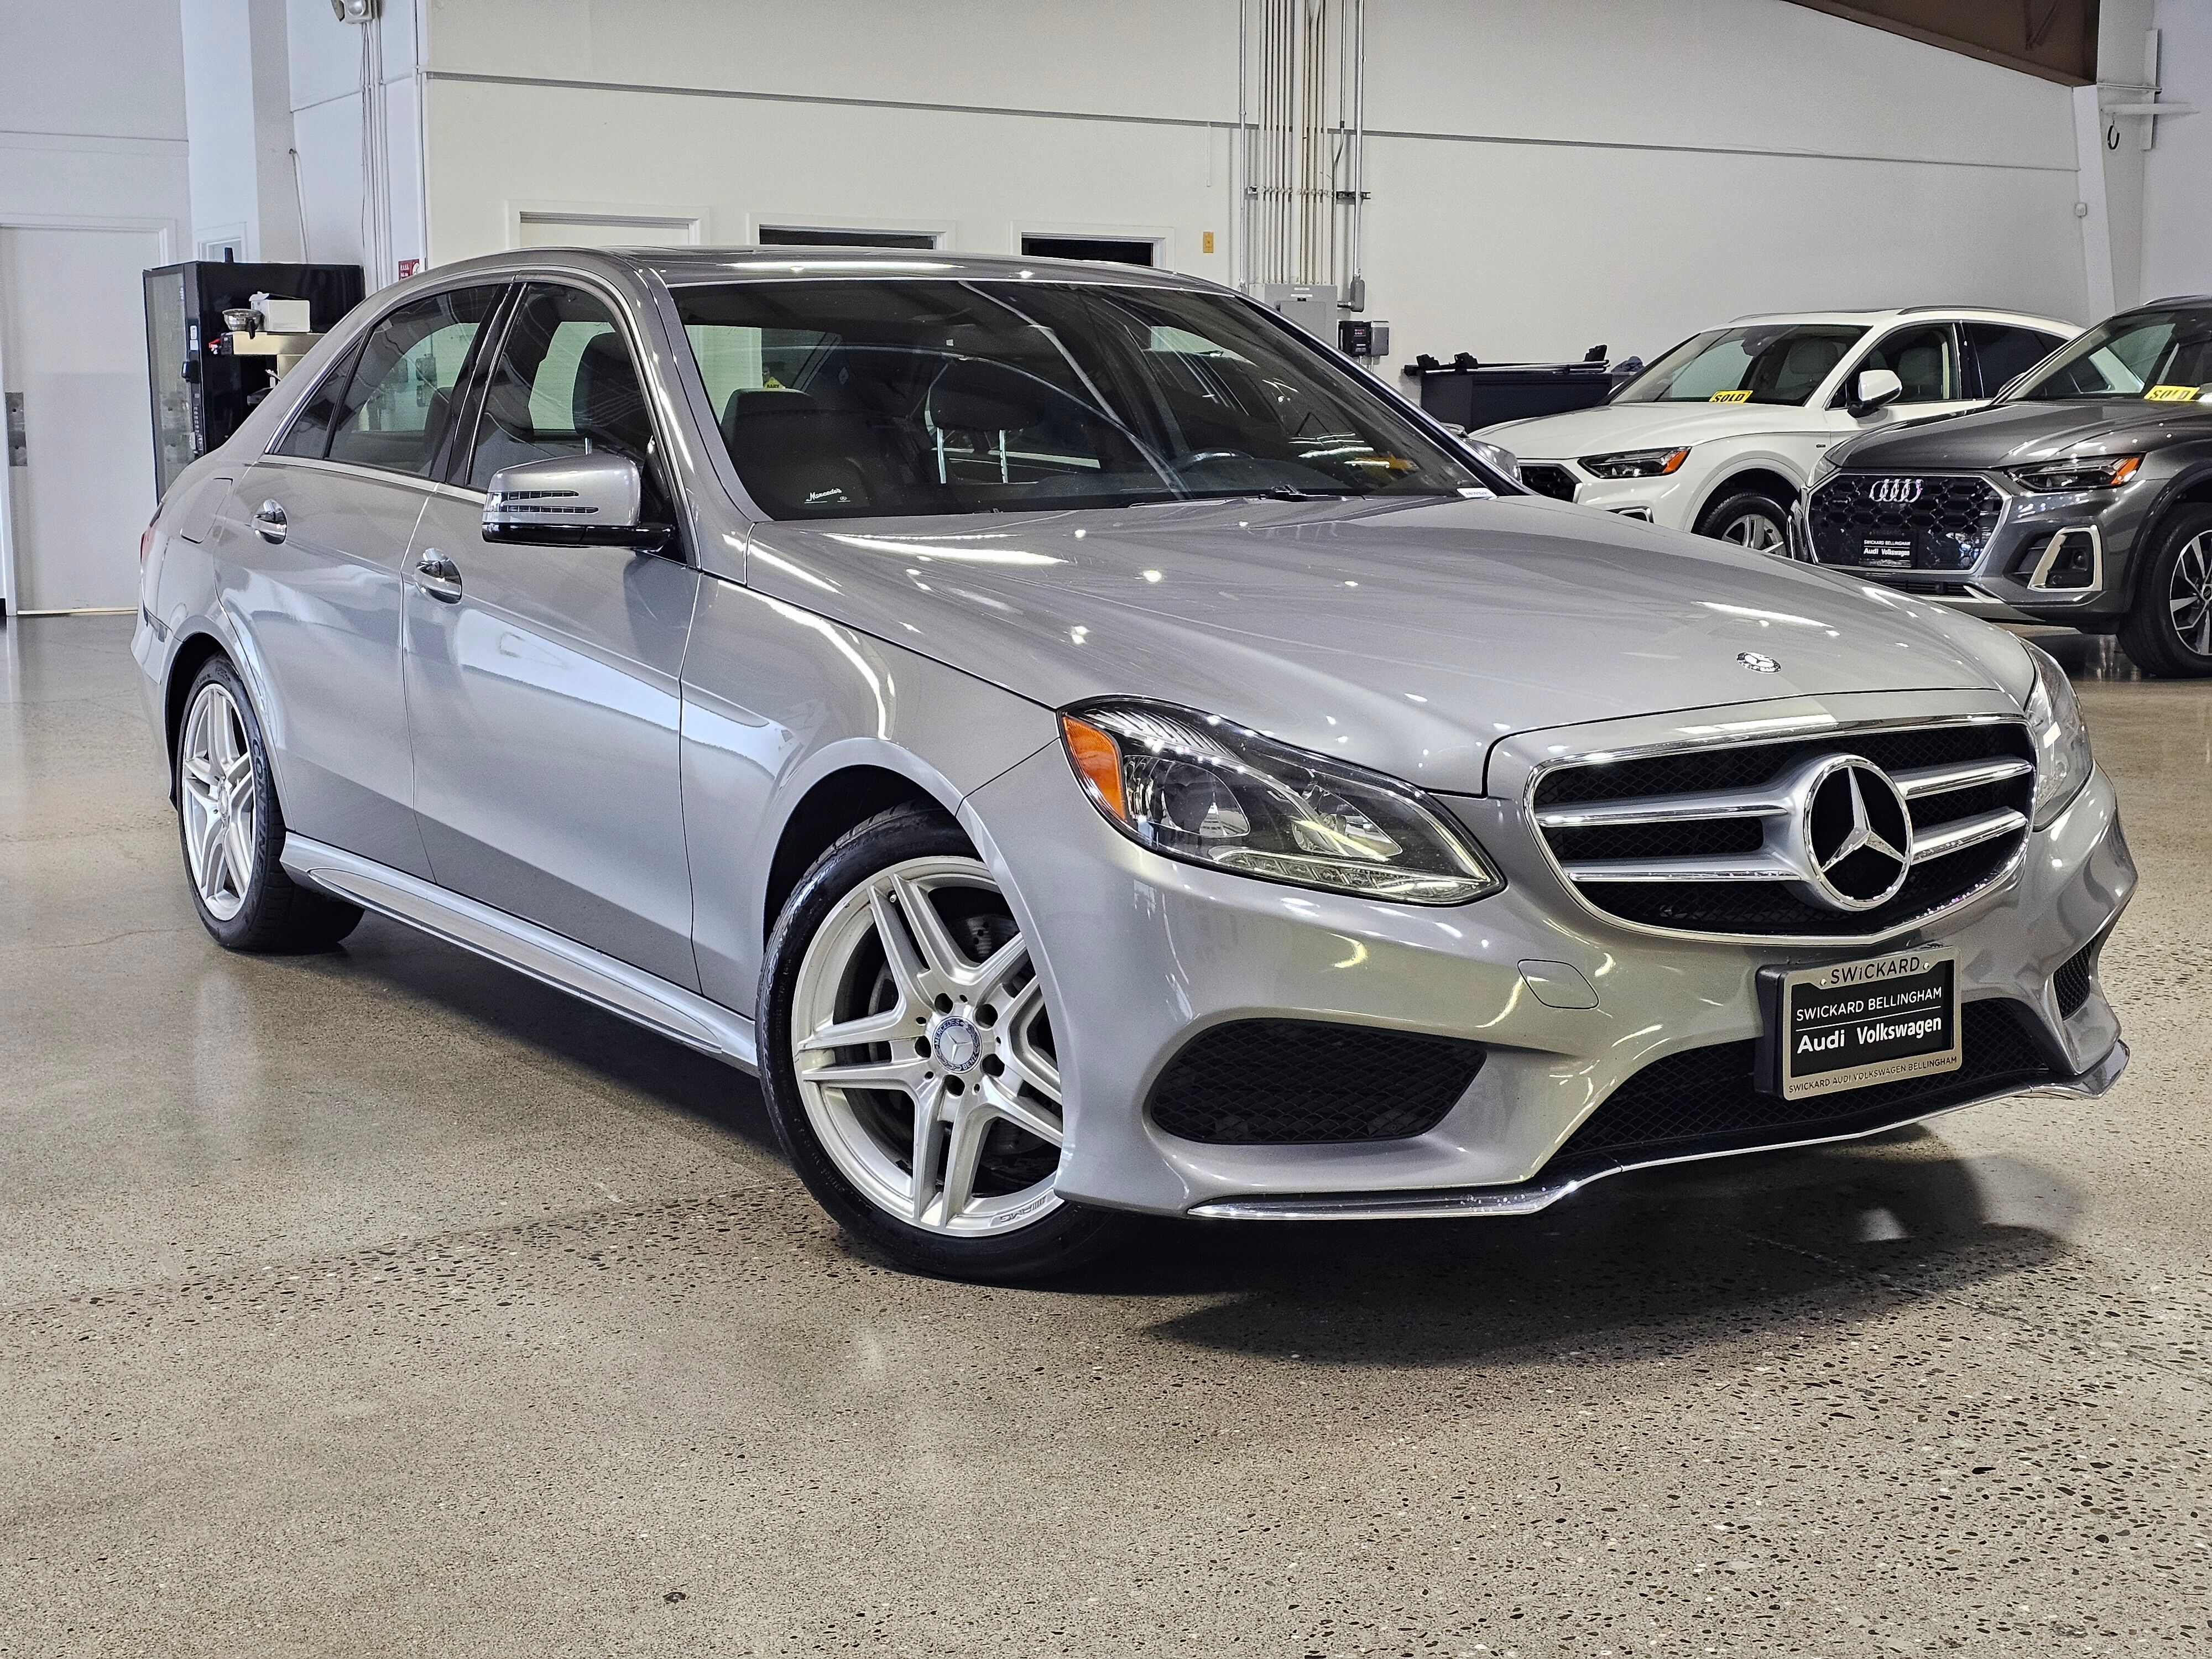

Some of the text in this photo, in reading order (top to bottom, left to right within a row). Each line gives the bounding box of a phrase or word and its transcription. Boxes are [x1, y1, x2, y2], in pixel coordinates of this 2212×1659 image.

[1712, 393, 1746, 403] SOLD
[2149, 390, 2190, 400] SOLD
[806, 488, 842, 502] Mercedes
[1881, 548, 1910, 557] Volkswagen
[1830, 956, 1921, 985] SWICKARD
[1796, 986, 1942, 1022] SWICKARD BELLINGHAM
[935, 1019, 960, 1045] MERCEDES
[1797, 1016, 1942, 1054] Audi Volkswagen
[962, 1053, 978, 1070] BENZ
[1788, 1055, 1958, 1093] SWICKARD AUDI VOLKSWAGEN BELLINGHAM
[1000, 1206, 1032, 1222] AMG
